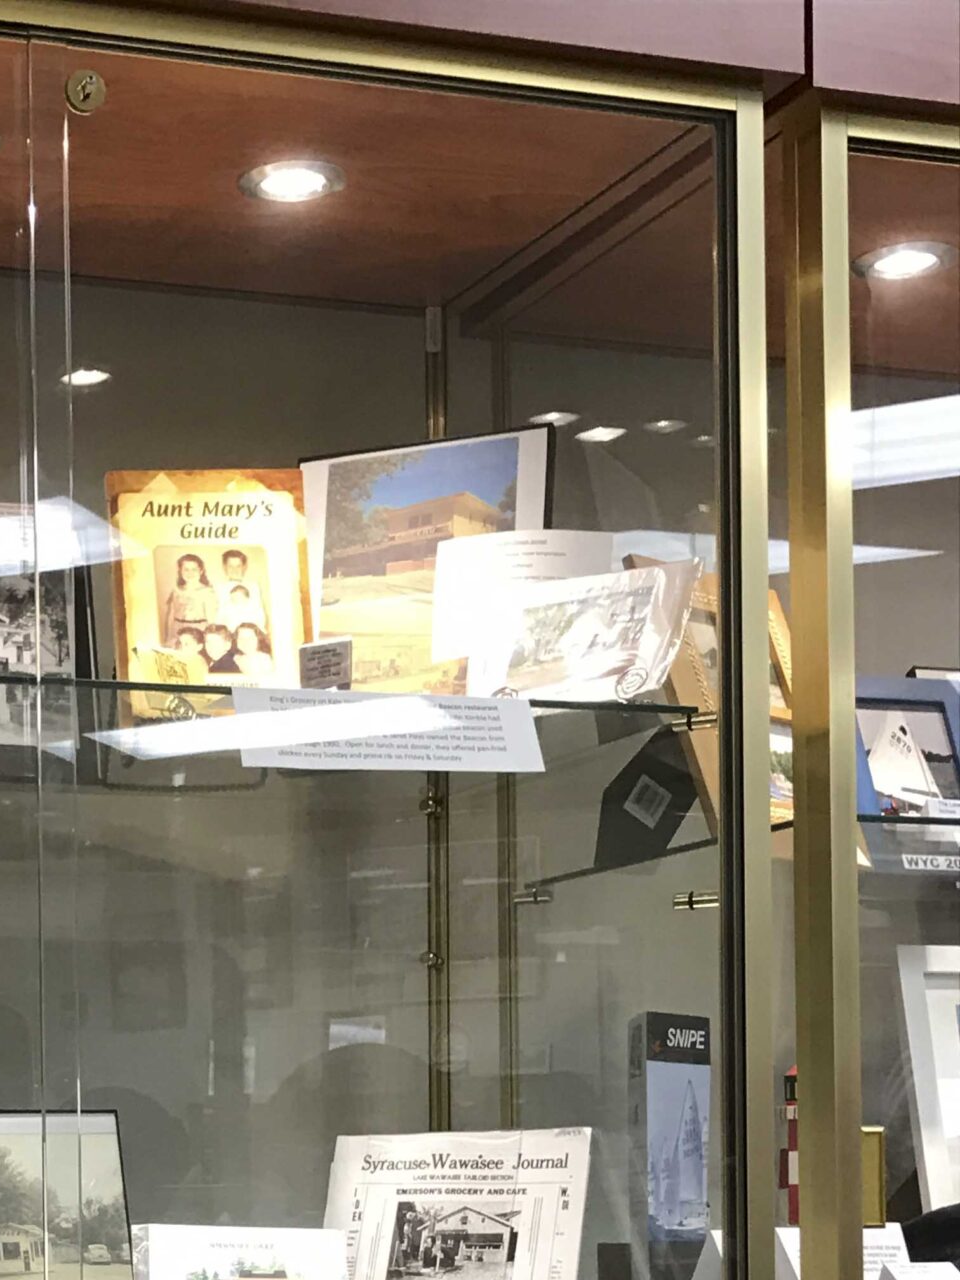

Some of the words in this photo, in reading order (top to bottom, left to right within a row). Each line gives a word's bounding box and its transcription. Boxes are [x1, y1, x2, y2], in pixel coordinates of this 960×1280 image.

[141, 500, 194, 518] Aunt
[202, 500, 273, 520] Mary's
[180, 523, 239, 539] Guide
[905, 856, 940, 869] WYC
[666, 1027, 705, 1050] SNIPE
[512, 1152, 569, 1171] Journal
